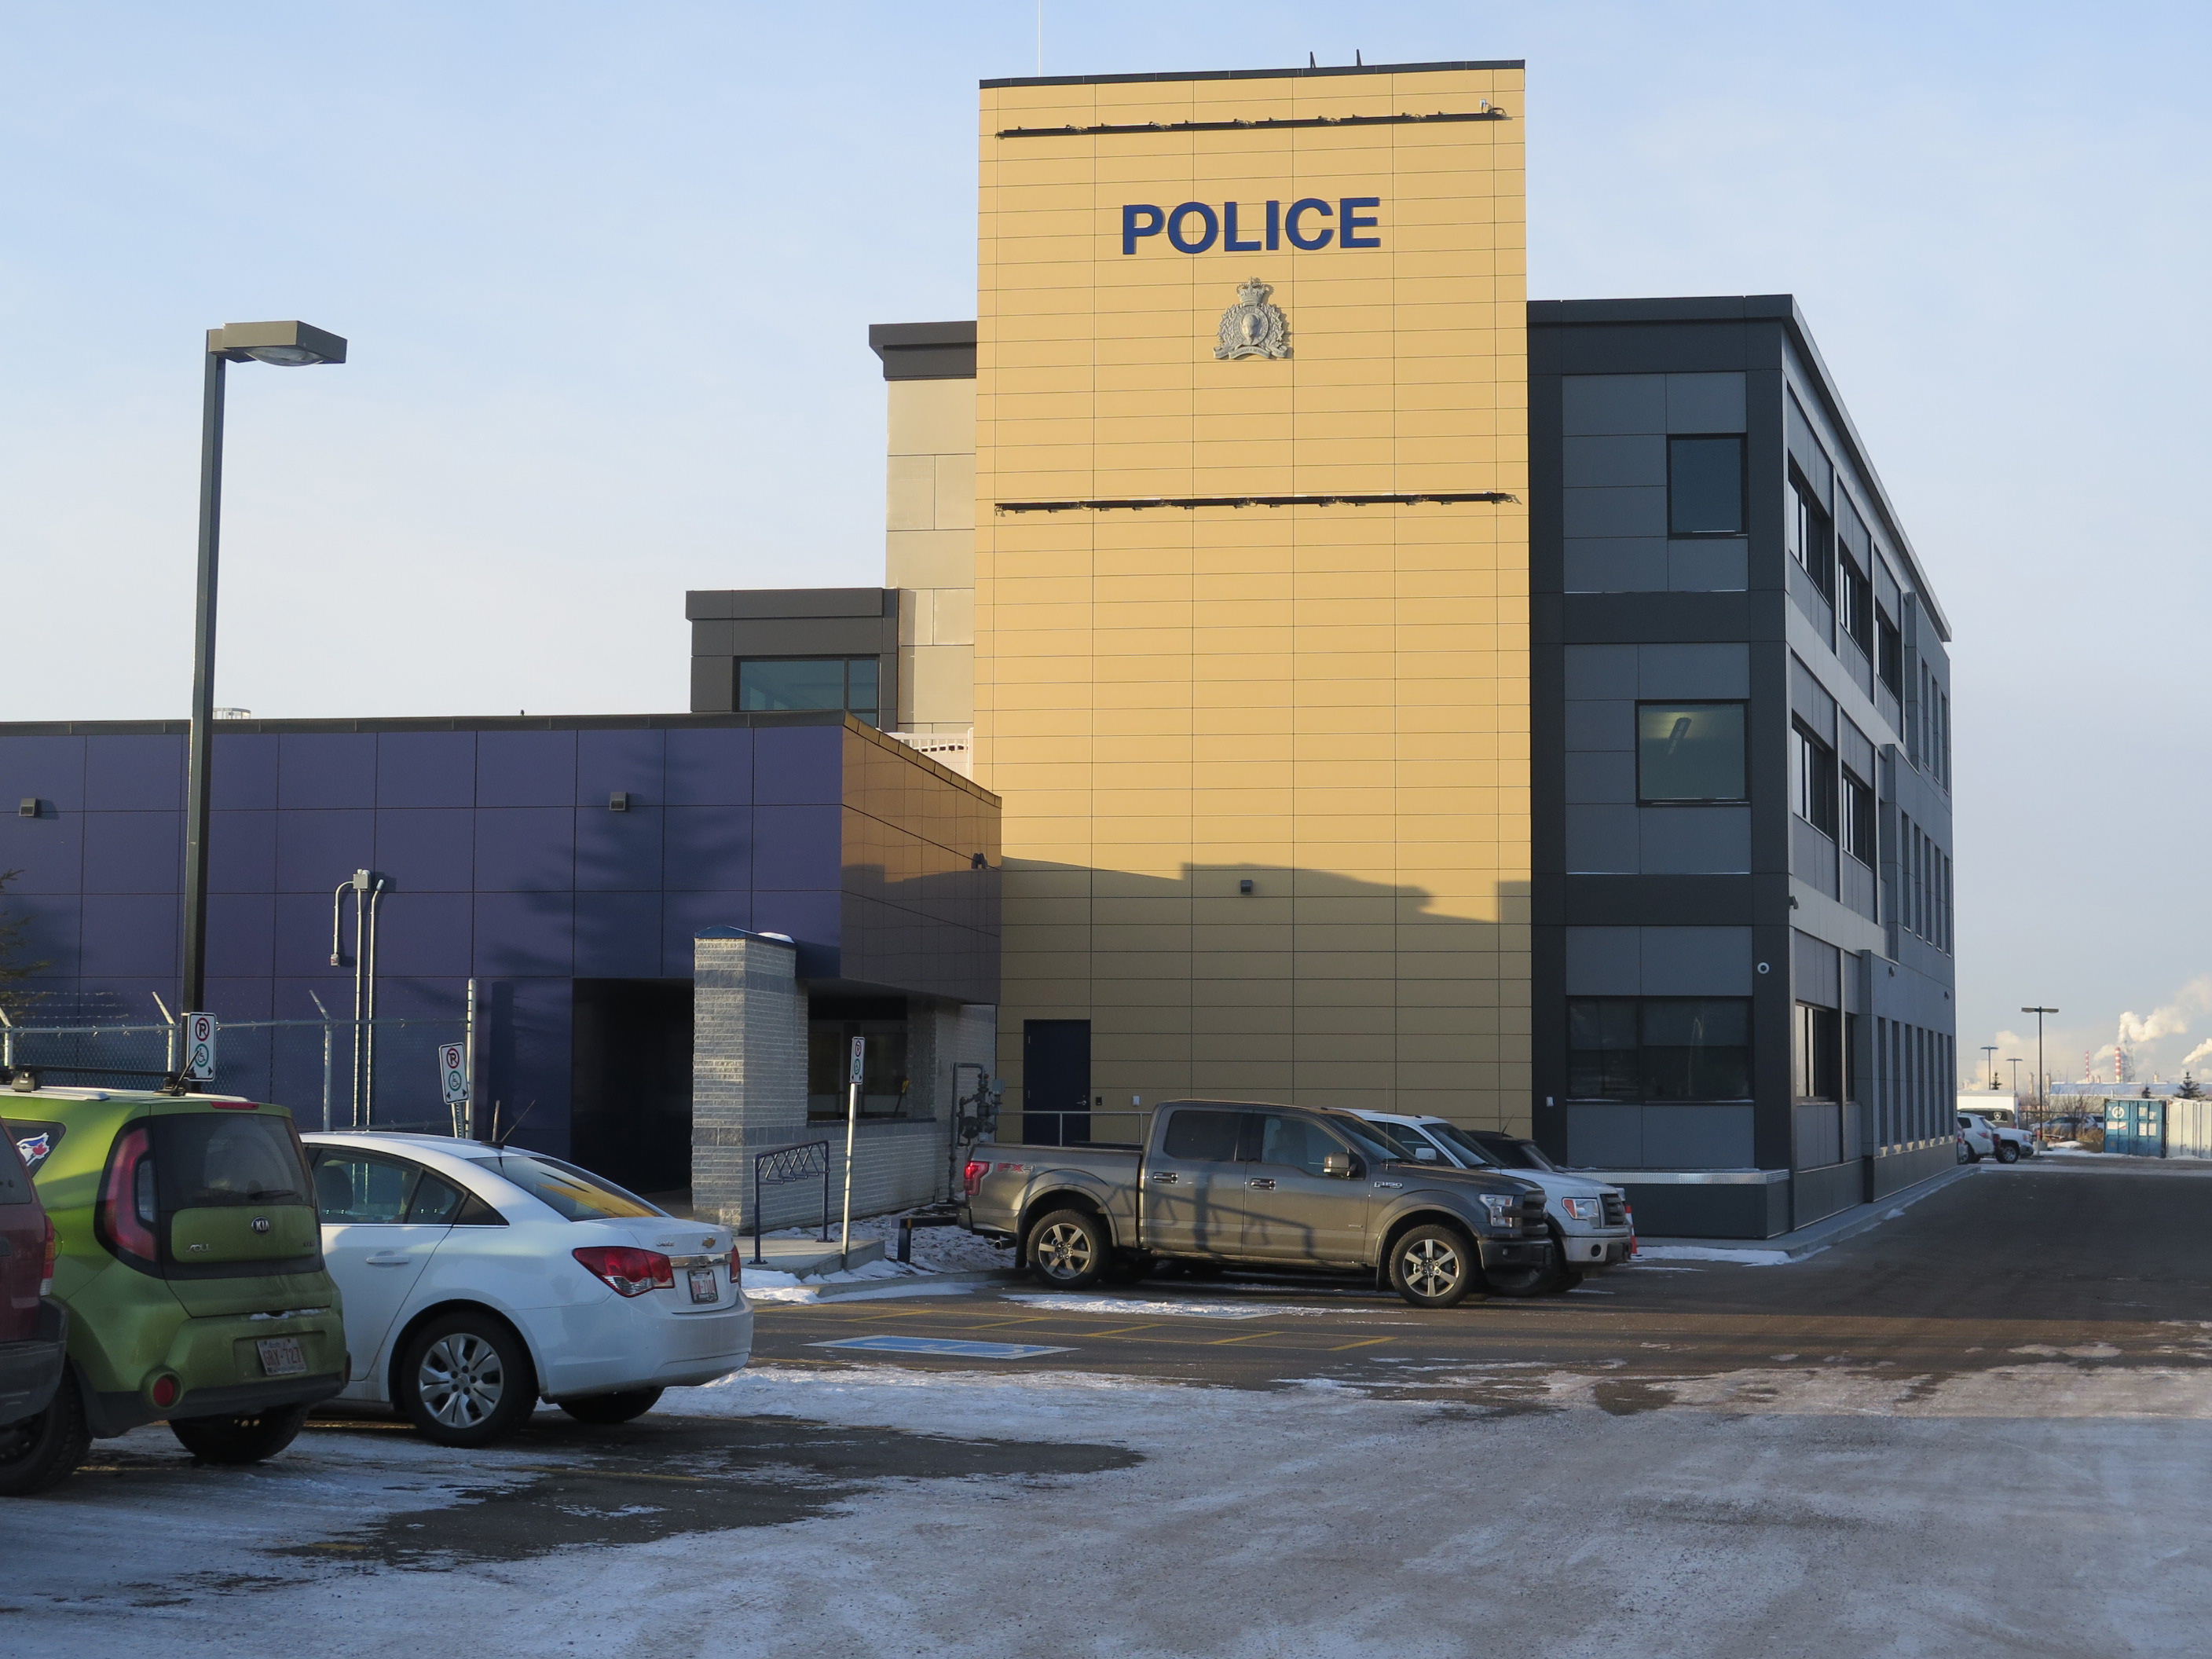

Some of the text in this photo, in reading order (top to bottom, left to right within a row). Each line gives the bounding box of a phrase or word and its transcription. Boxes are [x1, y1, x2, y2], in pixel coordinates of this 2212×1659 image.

[1122, 197, 1381, 255] POLICE
[997, 1163, 1036, 1173] FX4
[255, 1219, 270, 1231] KIA
